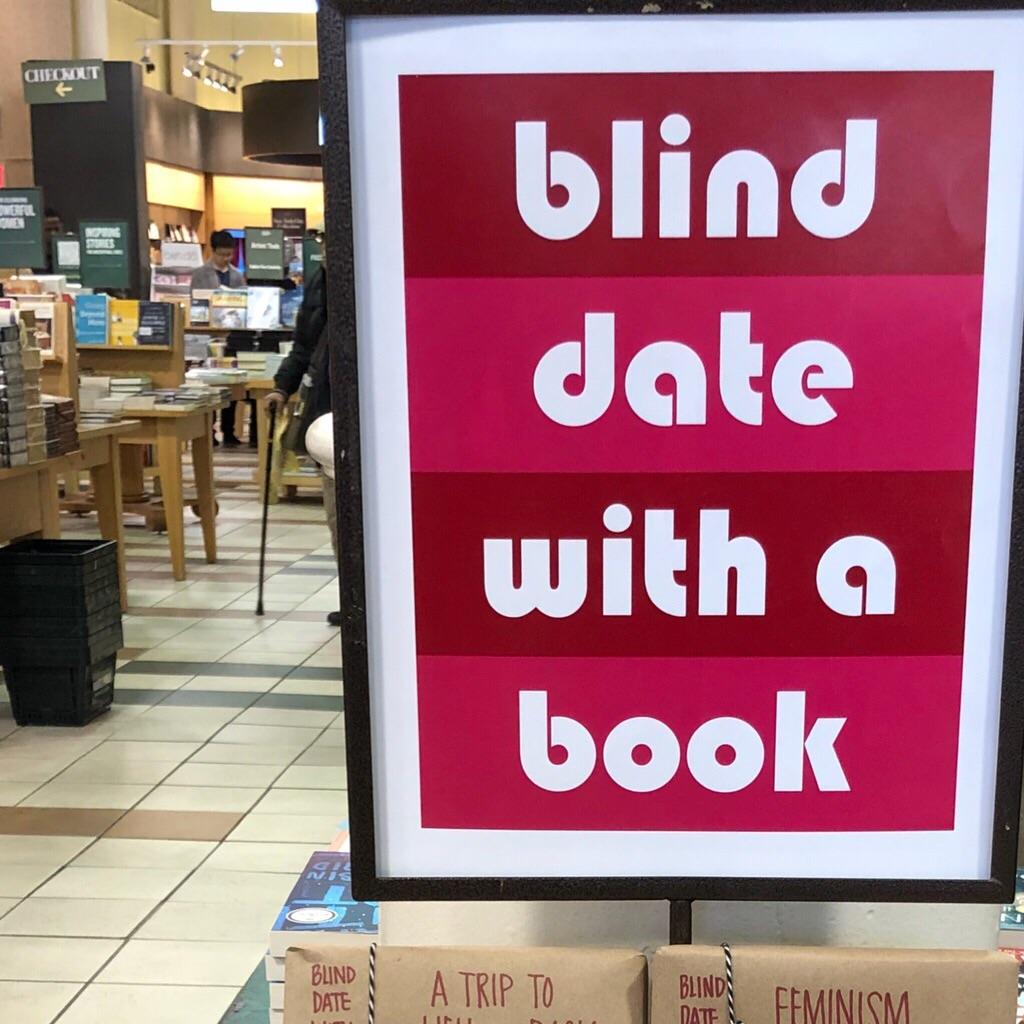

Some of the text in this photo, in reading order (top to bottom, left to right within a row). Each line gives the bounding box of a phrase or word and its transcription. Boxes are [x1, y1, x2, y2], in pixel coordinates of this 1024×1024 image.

[25, 66, 99, 81] CHECKOUT
[516, 114, 877, 239] blind
[534, 312, 853, 426] date
[484, 504, 897, 618] with a
[519, 691, 850, 792] book
[312, 964, 356, 986] BLIND
[459, 972, 513, 1008] TRIP
[680, 975, 726, 999] BLIND
[313, 991, 351, 1013] DATE
